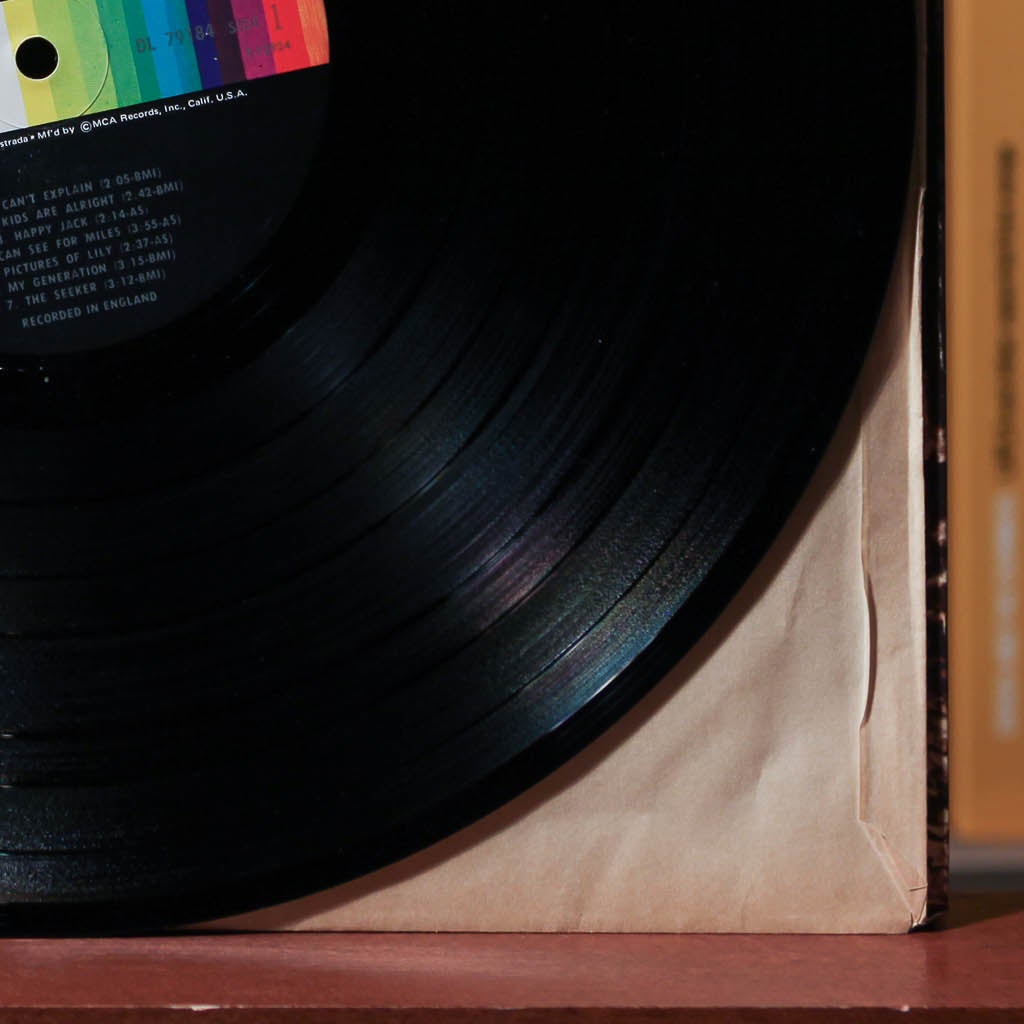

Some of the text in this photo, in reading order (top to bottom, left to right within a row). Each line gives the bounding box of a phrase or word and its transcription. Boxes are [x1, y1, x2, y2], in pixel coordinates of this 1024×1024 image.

[62, 125, 75, 136] by
[120, 107, 162, 122] Records,
[164, 103, 186, 114] Inc.,
[188, 95, 214, 108] Calif.
[216, 89, 248, 102] U.S.A.
[1, 211, 29, 227] KIDS
[36, 206, 58, 220] ARE
[65, 194, 114, 214] ALRIGHT
[2, 193, 36, 210] CAN'T
[43, 181, 93, 201] EXPLAIN
[14, 224, 52, 241] HAPPY
[60, 216, 88, 232] JACK
[28, 241, 49, 255] SEE
[56, 235, 77, 248] FOR
[85, 226, 121, 243] MILES
[3, 256, 59, 277] PICTURES
[66, 252, 80, 264] OF
[87, 245, 112, 259] LILY
[8, 280, 25, 293] MY
[33, 263, 107, 287] GENERATION
[24, 292, 47, 306] THE
[54, 282, 97, 300] SEEKER
[22, 291, 158, 328] RECORDED IN ENGLAND
